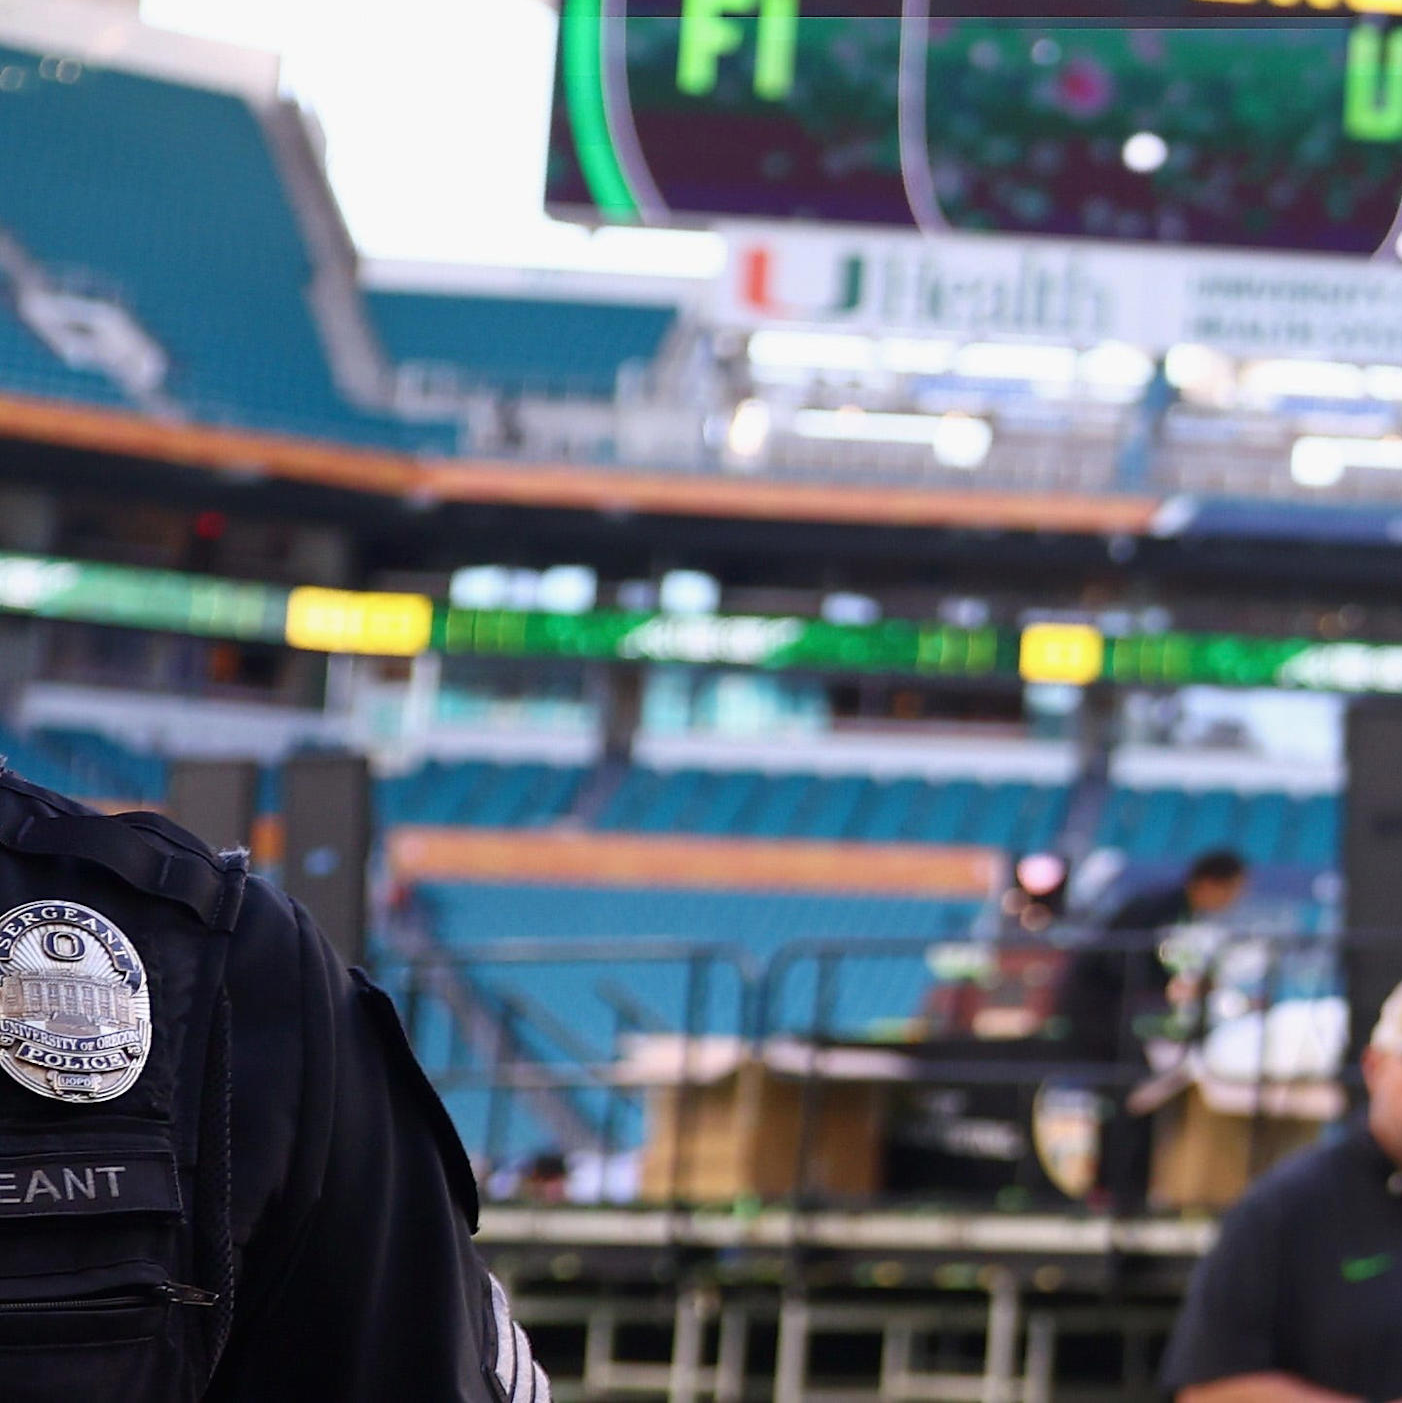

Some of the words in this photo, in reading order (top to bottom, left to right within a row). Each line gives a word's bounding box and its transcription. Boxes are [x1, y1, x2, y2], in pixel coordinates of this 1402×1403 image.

[0, 905, 129, 960] SERGEANT
[0, 1019, 78, 1051] UNIVERSITY
[96, 1030, 139, 1051] OREGON
[25, 1045, 123, 1070] POLICE
